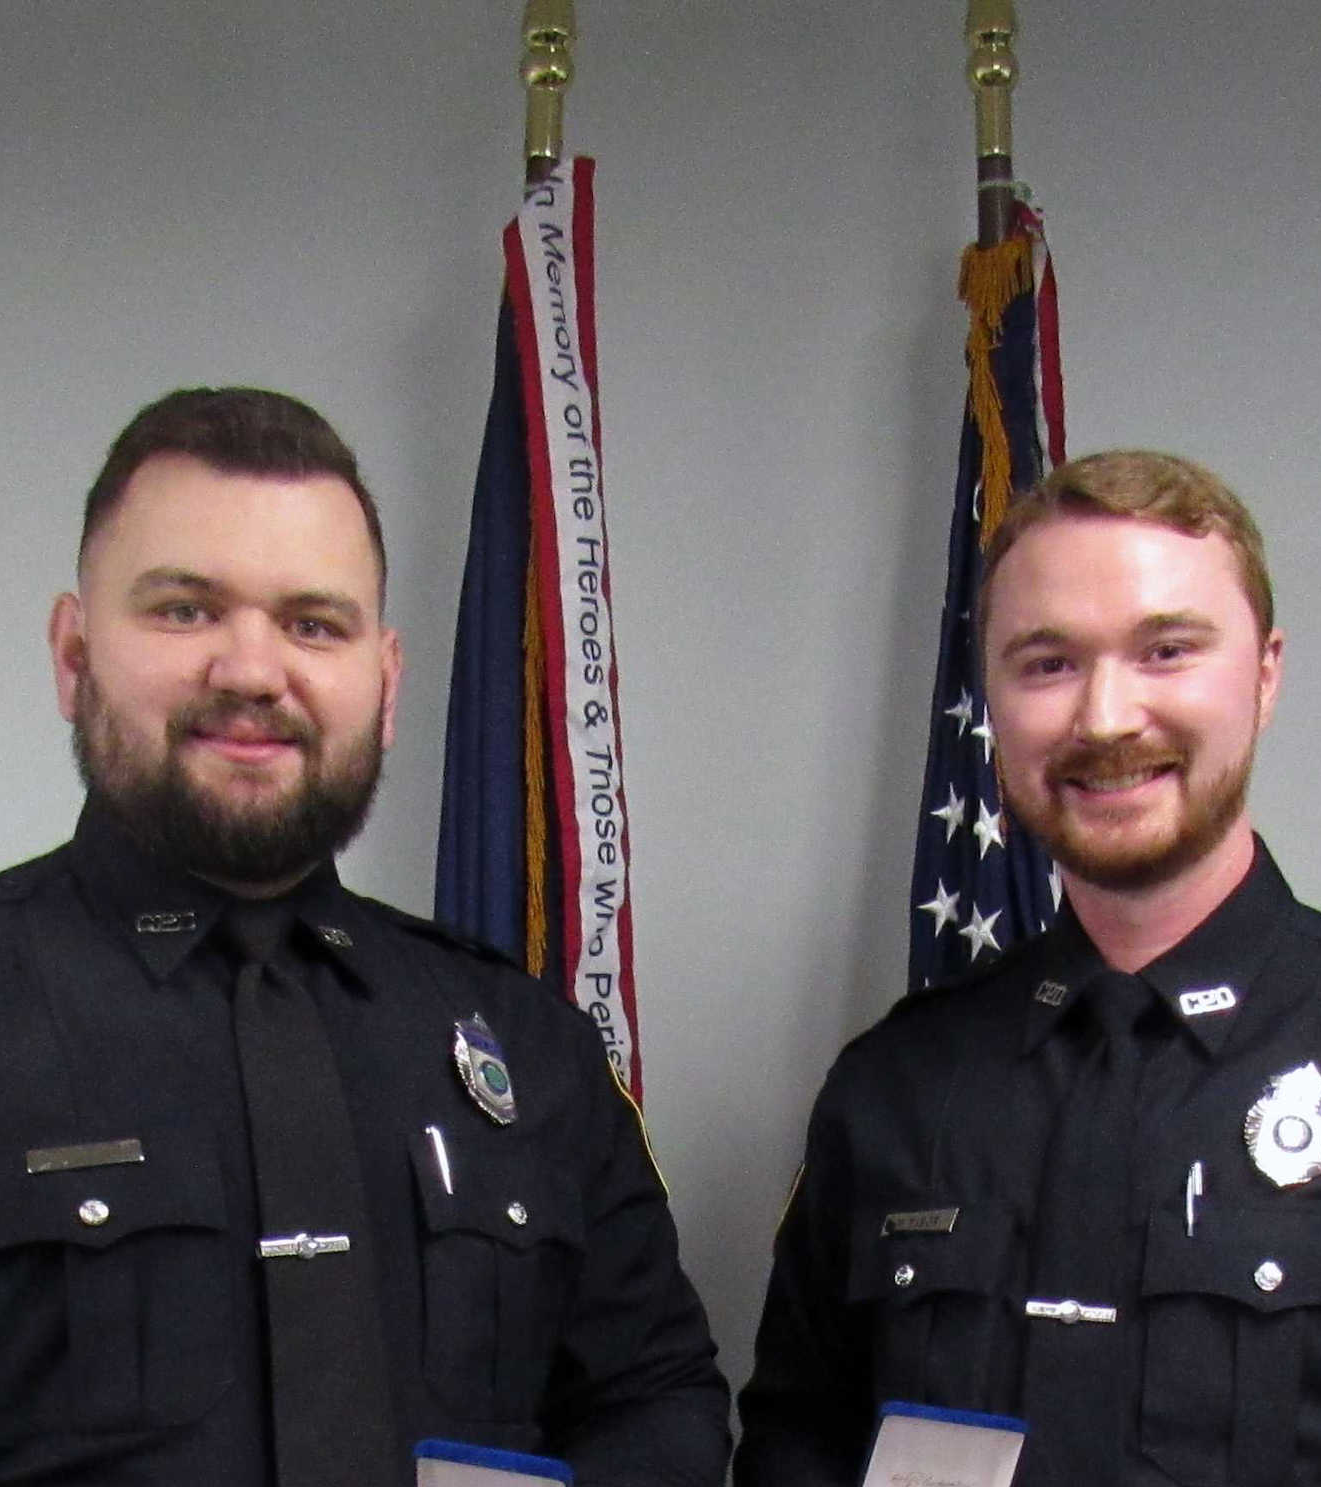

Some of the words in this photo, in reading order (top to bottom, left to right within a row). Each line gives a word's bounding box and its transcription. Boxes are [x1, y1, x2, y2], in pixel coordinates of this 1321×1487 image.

[539, 222, 579, 391] Memory
[564, 404, 590, 449] of
[569, 457, 595, 521] the
[577, 537, 604, 685] Heroes
[584, 700, 608, 728] &
[586, 744, 616, 865] Those
[586, 973, 625, 1076] Peris
